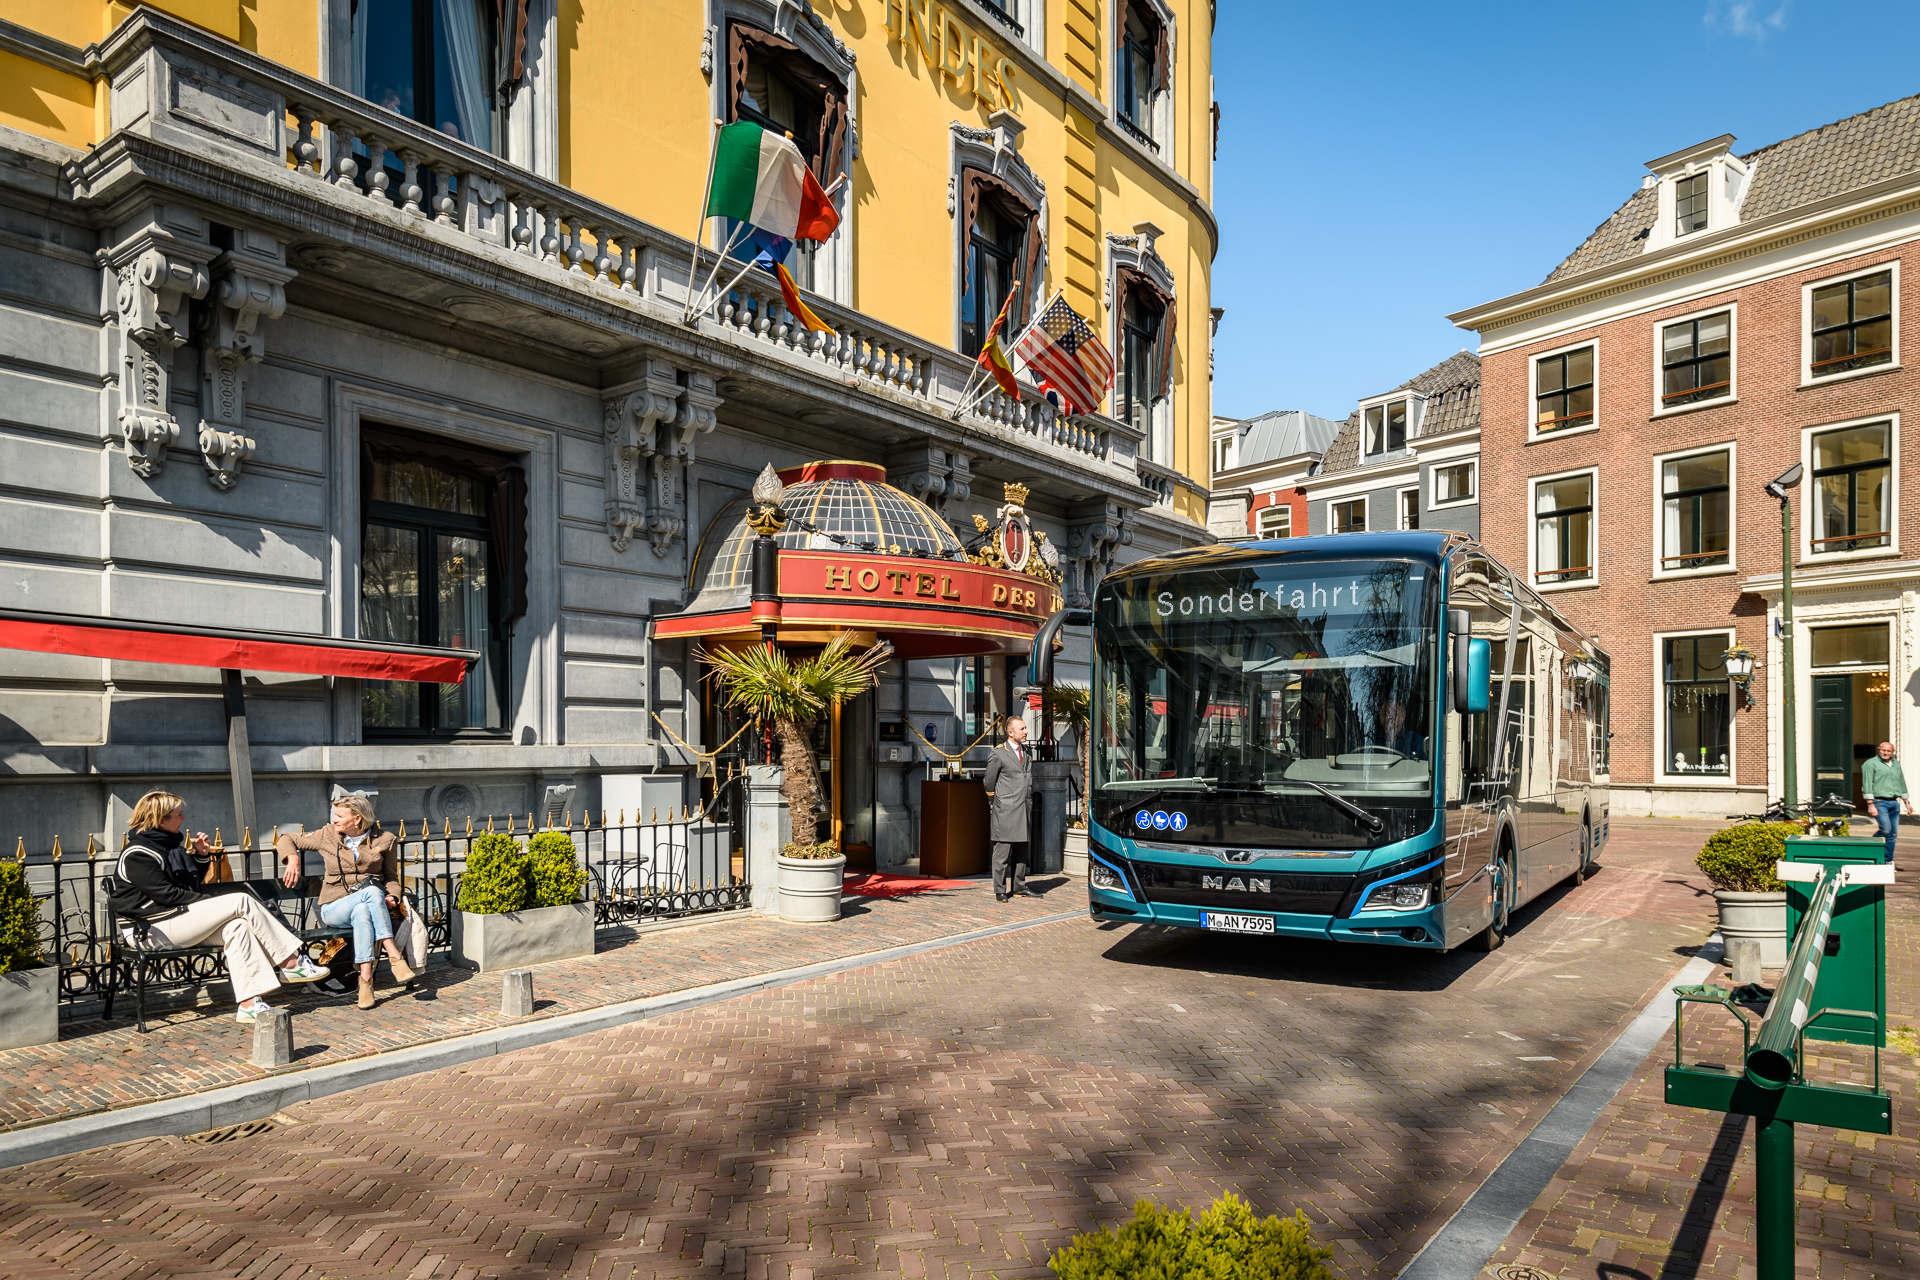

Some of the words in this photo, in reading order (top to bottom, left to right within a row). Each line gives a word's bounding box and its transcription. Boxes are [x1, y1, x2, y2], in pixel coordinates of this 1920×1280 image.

[825, 565, 960, 599] HOTEL
[993, 583, 1036, 608] DES
[1156, 580, 1359, 617] Sonderfahrt
[1202, 875, 1271, 894] MAN
[1207, 914, 1216, 927] M
[1223, 915, 1239, 929] AN
[1241, 917, 1273, 931] 7595
